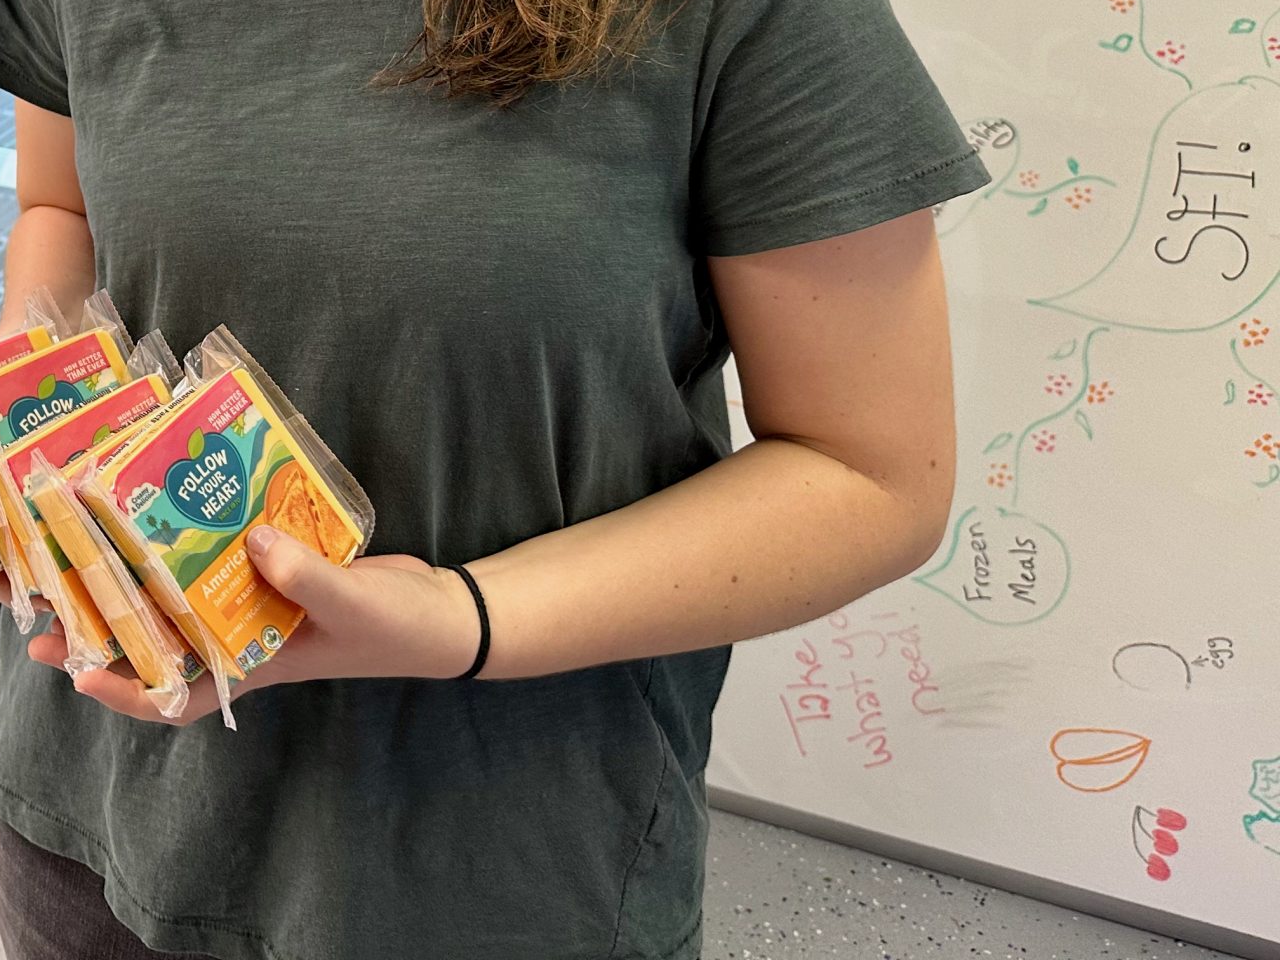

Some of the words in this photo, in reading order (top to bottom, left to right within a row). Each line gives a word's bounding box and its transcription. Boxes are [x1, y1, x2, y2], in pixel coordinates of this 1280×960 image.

[63, 362, 78, 374] NOW
[77, 351, 103, 367] BETTER
[66, 367, 87, 381] THAN
[86, 358, 107, 373] EVER
[19, 398, 74, 433] FOLLOW
[208, 408, 222, 425] NOW
[220, 389, 243, 412] BETTER
[212, 411, 232, 431] THAN
[229, 396, 248, 415] EVER
[178, 449, 228, 501] FOLLOW
[198, 470, 226, 498] YOUR
[131, 487, 149, 504] Creamy
[200, 475, 241, 519] HEART
[201, 546, 248, 600] America
[962, 521, 992, 601] Frozen
[1007, 535, 1037, 604] Meals
[1207, 636, 1233, 669] egg
[779, 639, 832, 757] Take
